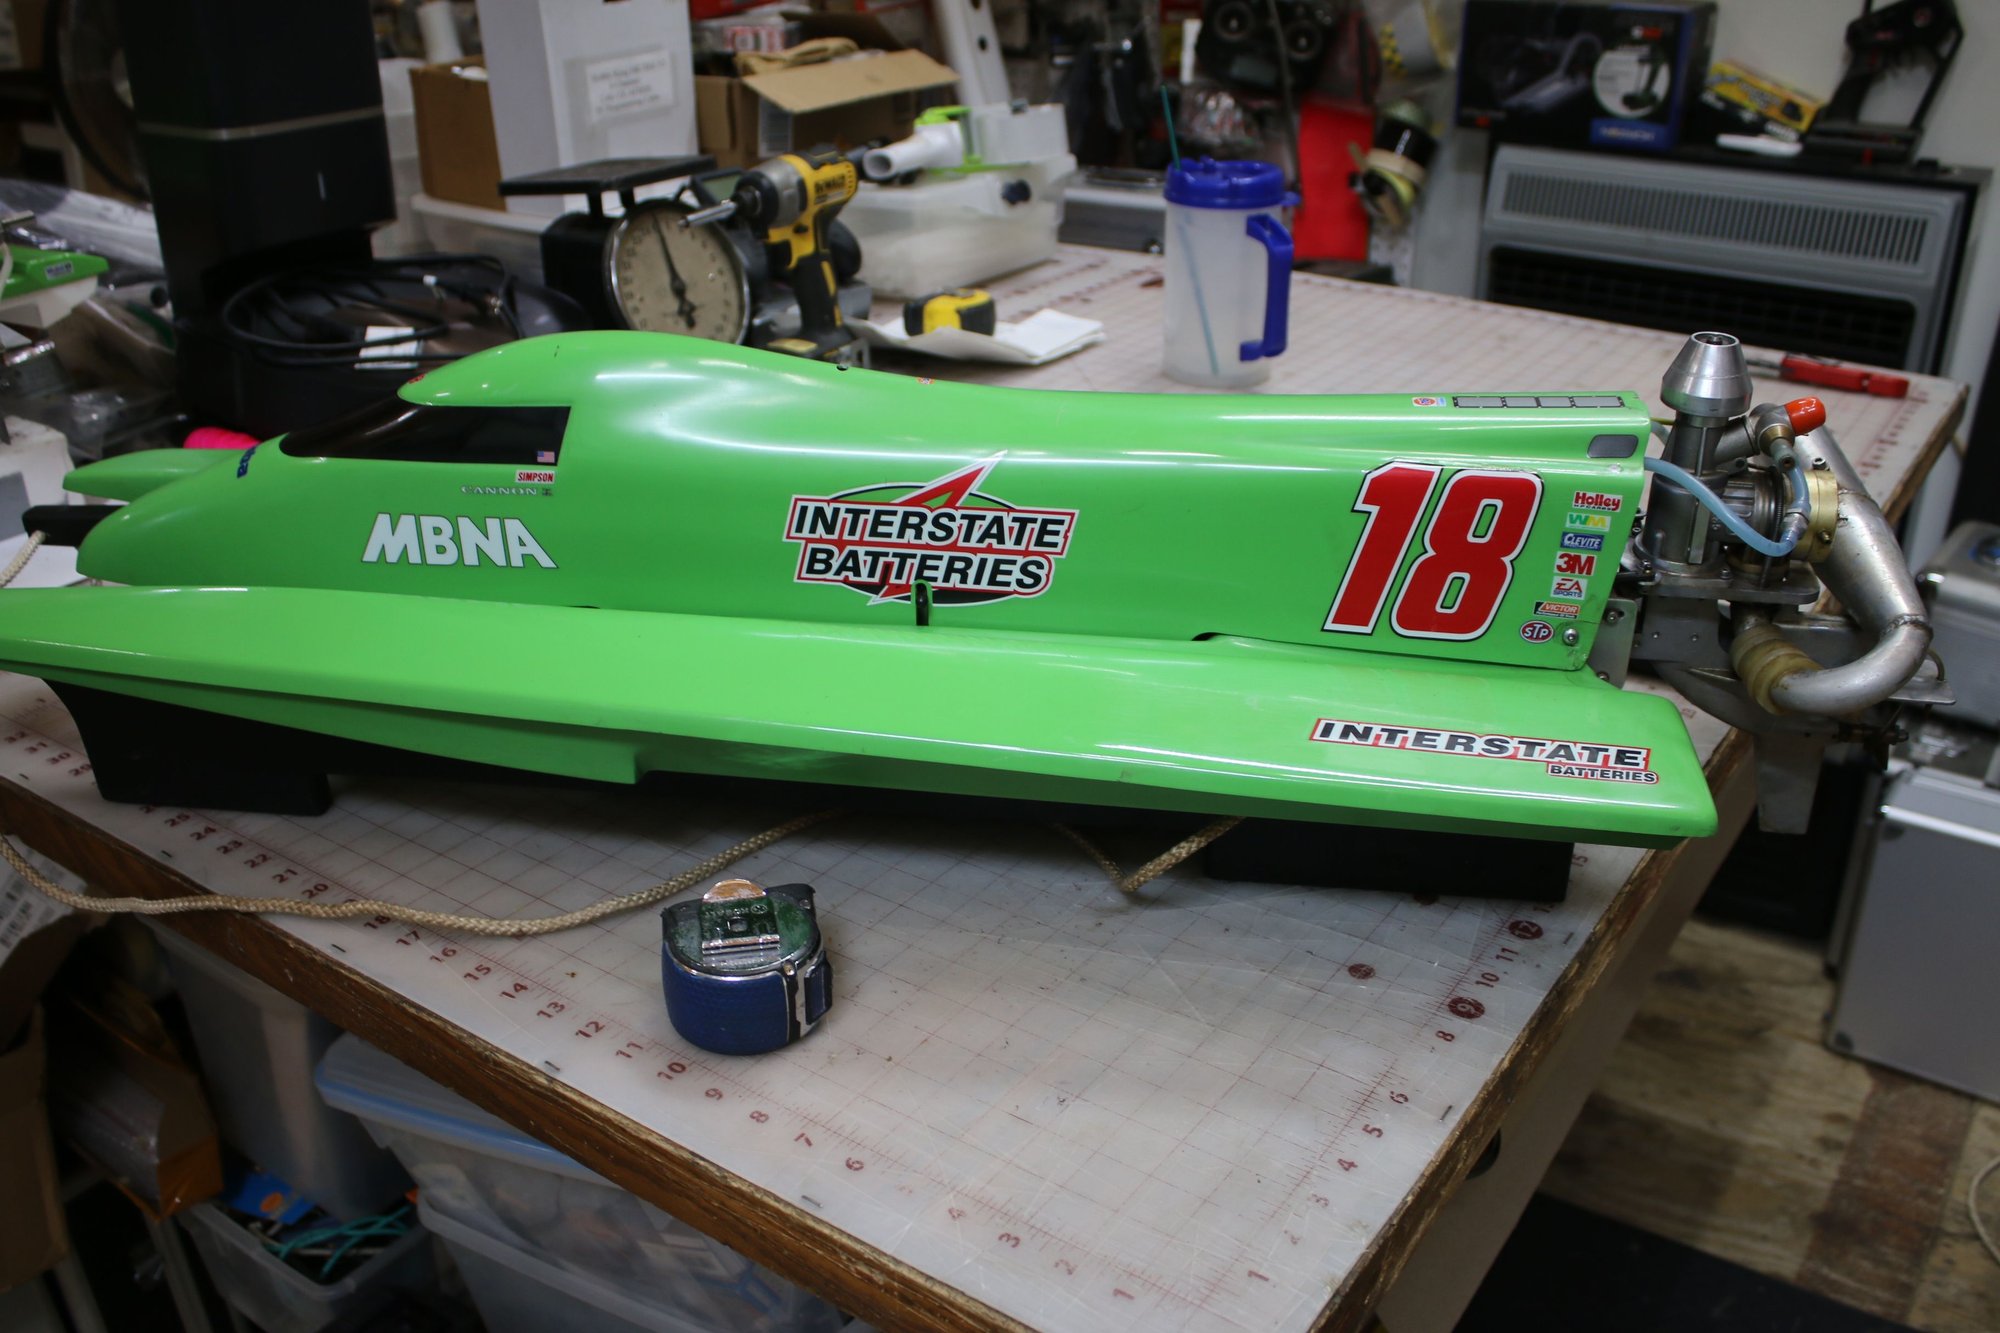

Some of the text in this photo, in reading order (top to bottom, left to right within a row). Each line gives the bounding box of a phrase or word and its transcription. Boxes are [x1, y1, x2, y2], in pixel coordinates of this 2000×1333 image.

[517, 472, 555, 482] SIMPSON
[460, 485, 537, 497] CANNON
[1574, 491, 1621, 512] Holley
[794, 505, 1066, 549] INTERSTATE
[1568, 512, 1607, 529] WM
[361, 512, 559, 569] MBNA
[1563, 533, 1602, 550] CLEVITE
[1321, 461, 1544, 642] 18
[804, 547, 1046, 593] BATTERIES
[1556, 553, 1595, 576] 3M
[1553, 589, 1583, 598] SPORTS
[1555, 578, 1583, 592] EA
[1545, 602, 1578, 615] VICTOR
[1523, 624, 1550, 639] STP
[1319, 722, 1643, 769] INTERSTATE
[1550, 765, 1656, 783] BATTERIES
[272, 868, 299, 884] 21
[302, 883, 329, 899] 20
[395, 930, 422, 947] 17
[430, 947, 457, 963] 16
[1496, 947, 1520, 963] 11
[464, 964, 492, 981] 15
[1475, 972, 1500, 988] 10
[500, 982, 529, 1000] 14
[536, 1001, 566, 1019] 13
[575, 1021, 606, 1039] 12
[615, 1041, 644, 1059] 11
[657, 1062, 687, 1080] 10
[1362, 1124, 1384, 1138] 5
[1337, 1158, 1358, 1171] 4
